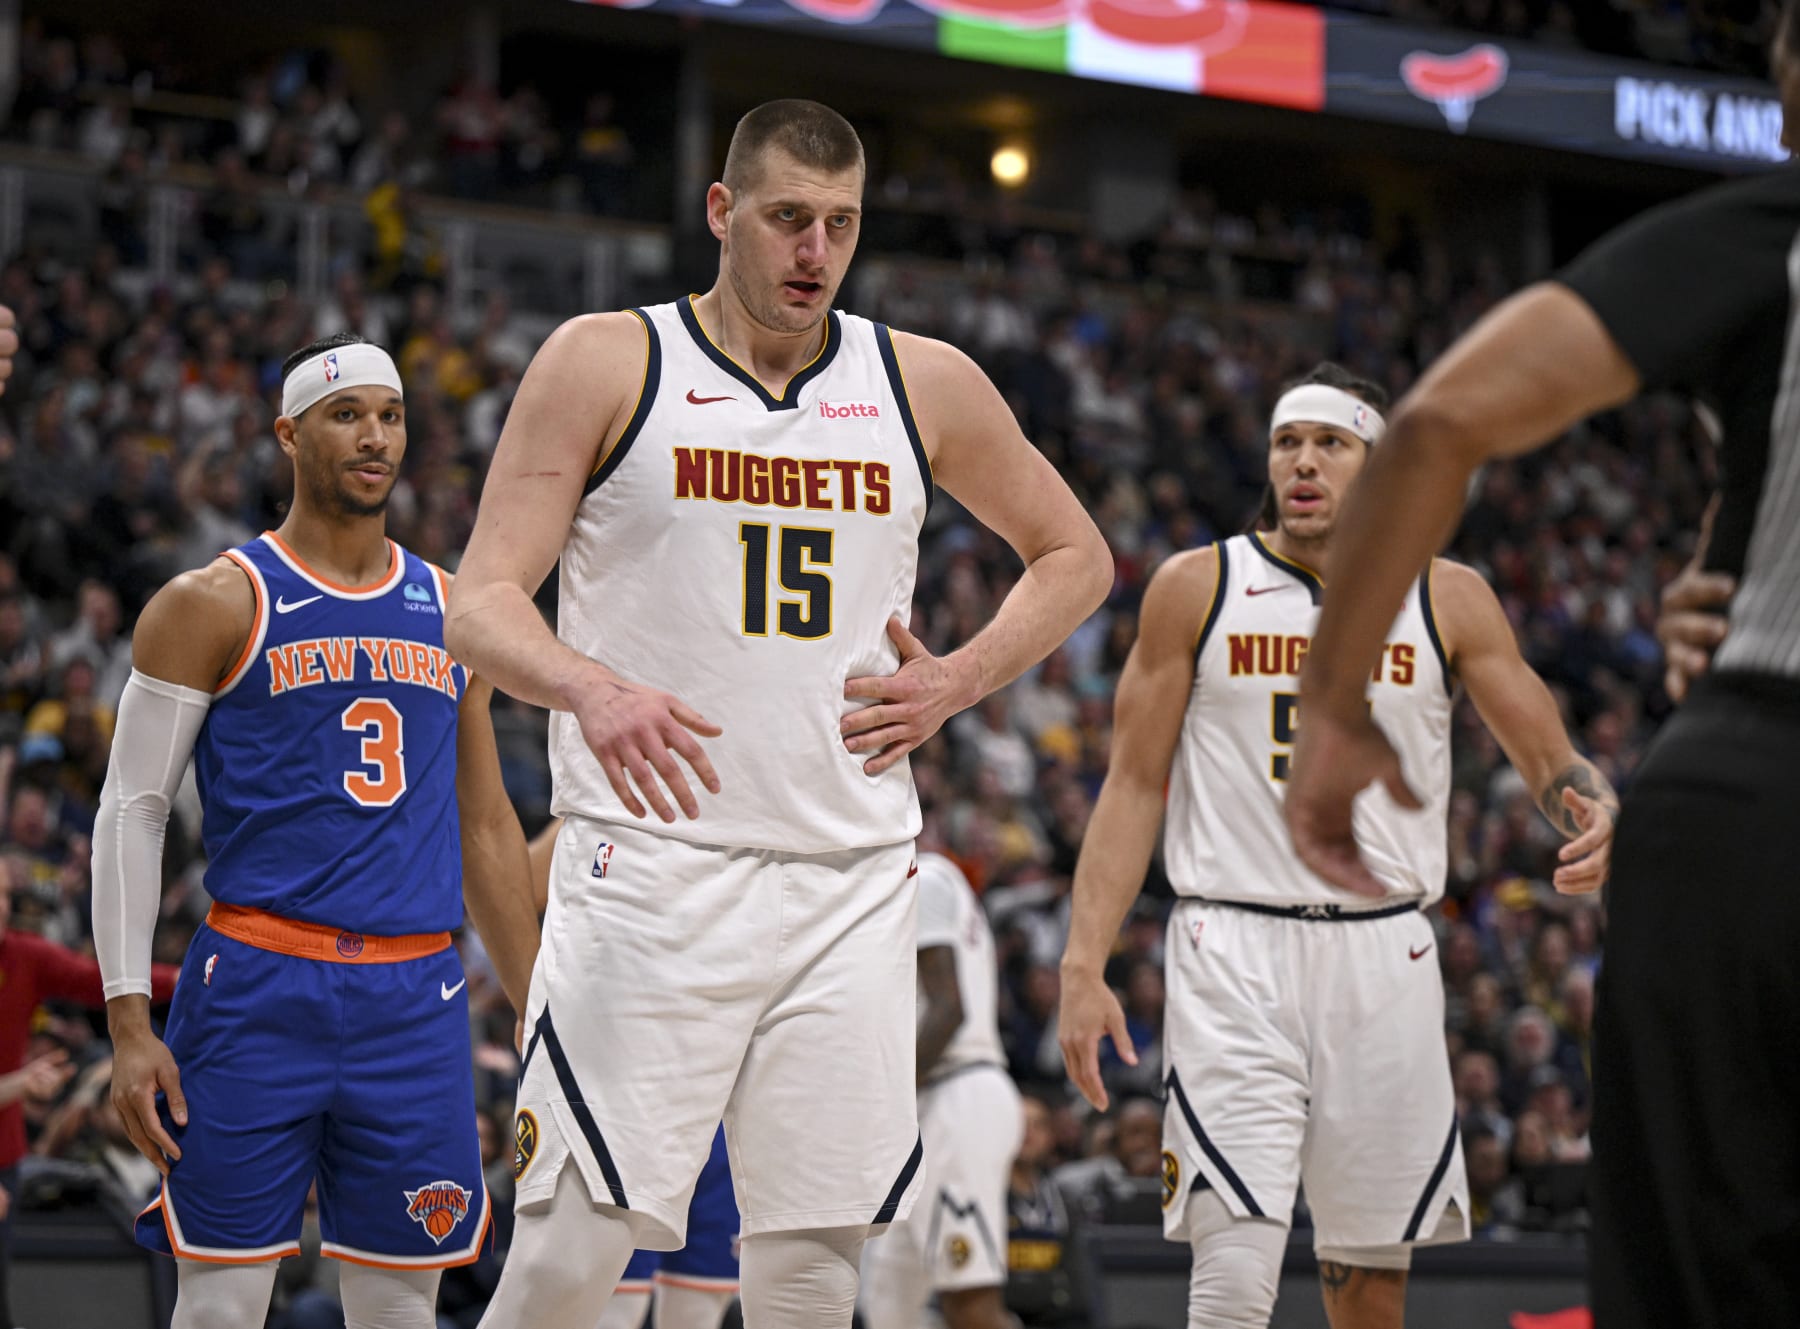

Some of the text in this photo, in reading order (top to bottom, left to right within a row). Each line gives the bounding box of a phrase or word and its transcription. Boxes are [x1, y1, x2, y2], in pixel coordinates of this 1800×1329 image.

[1614, 77, 1709, 152] PICK
[819, 402, 880, 419] ibotta
[672, 446, 893, 517] NUGGETS
[738, 520, 835, 641] 15
[266, 636, 458, 701] NEW YORK
[341, 697, 407, 807] 3
[410, 1187, 467, 1213] KNICKS
